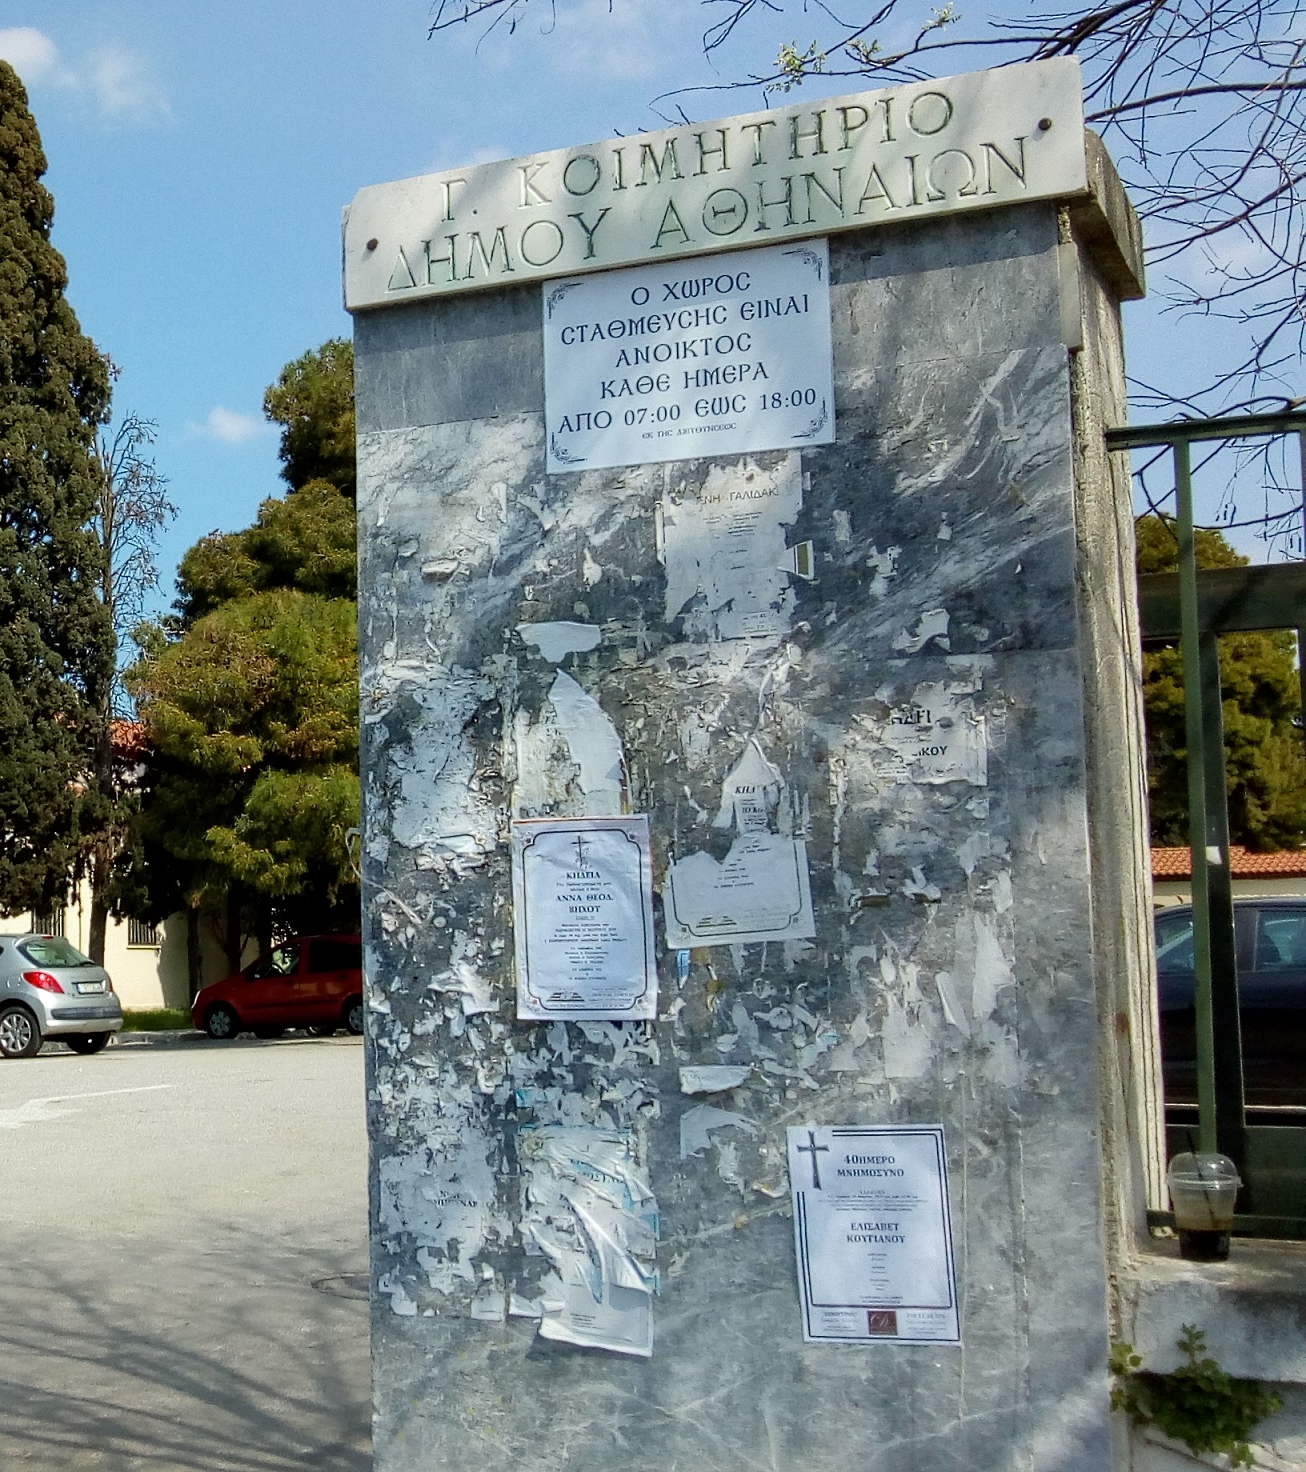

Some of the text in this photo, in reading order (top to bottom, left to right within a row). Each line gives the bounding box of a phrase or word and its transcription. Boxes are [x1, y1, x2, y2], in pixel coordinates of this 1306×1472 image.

[517, 91, 955, 210] ΚΟΙΜΗΤΗΡΙΟ
[386, 136, 1029, 292] ΔΗΜΟΥ ΑΘΗΝΑΙΩΝ
[623, 404, 682, 427] 07:00
[758, 387, 818, 411] 18:00
